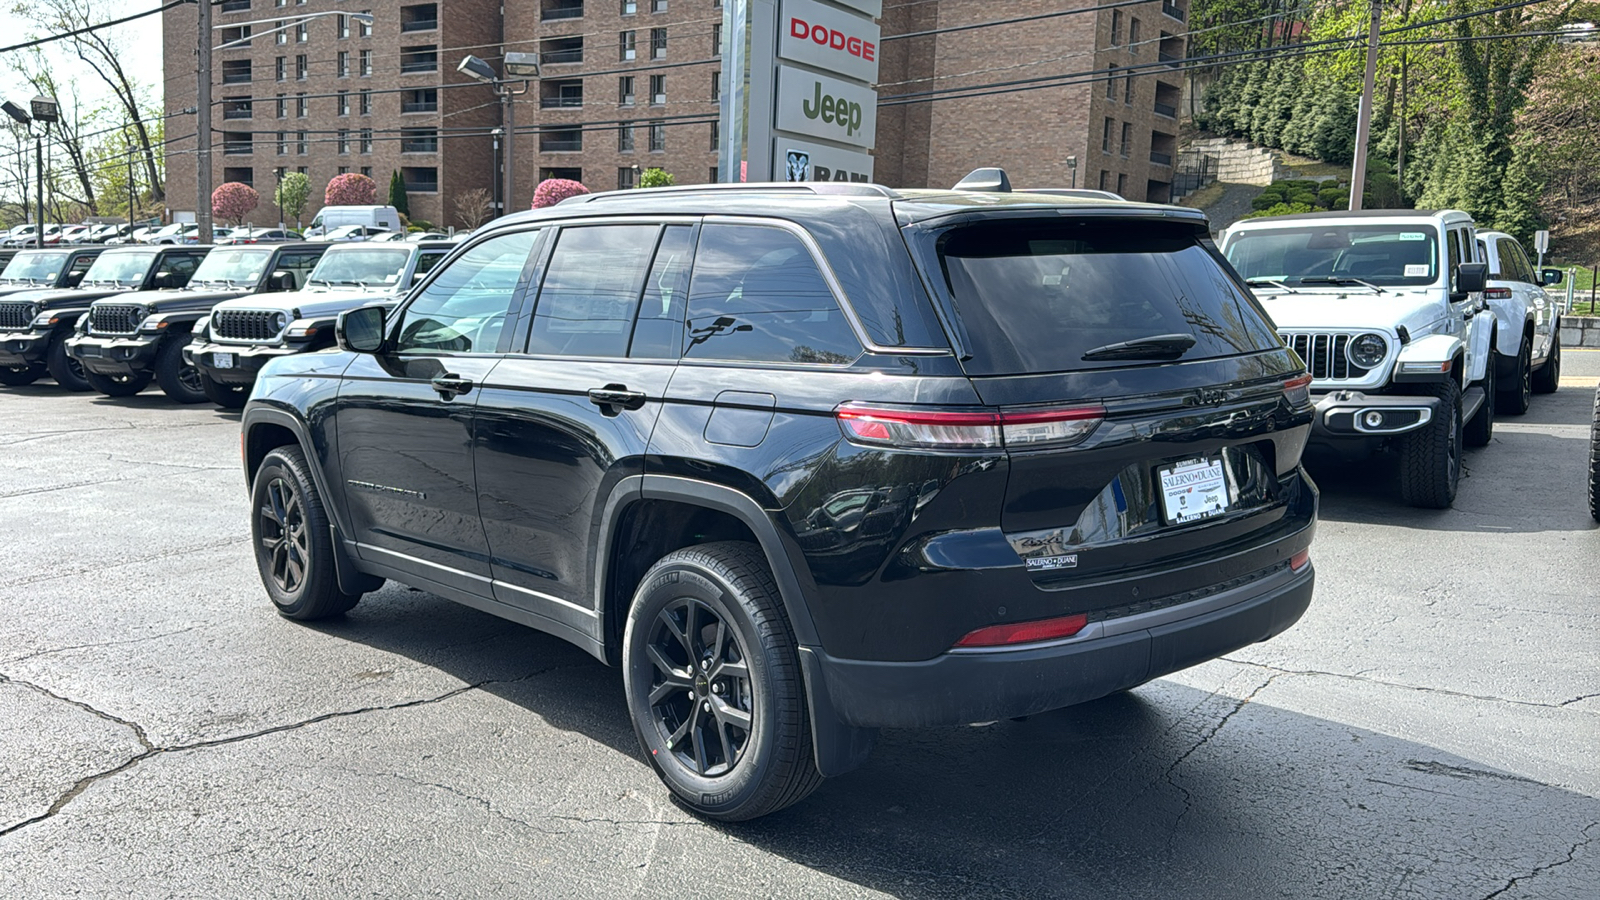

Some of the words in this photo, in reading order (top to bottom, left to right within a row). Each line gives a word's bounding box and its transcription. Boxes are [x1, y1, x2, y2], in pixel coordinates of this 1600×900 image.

[790, 17, 875, 62] DODGE
[803, 81, 862, 137] Jeep
[1163, 473, 1195, 488] SALERNO
[1197, 467, 1221, 480] DUANE
[1204, 495, 1219, 504] Jeep
[1176, 514, 1201, 524] SALERNO
[1027, 558, 1053, 567] SALERNO
[1057, 556, 1076, 564] DUANE
